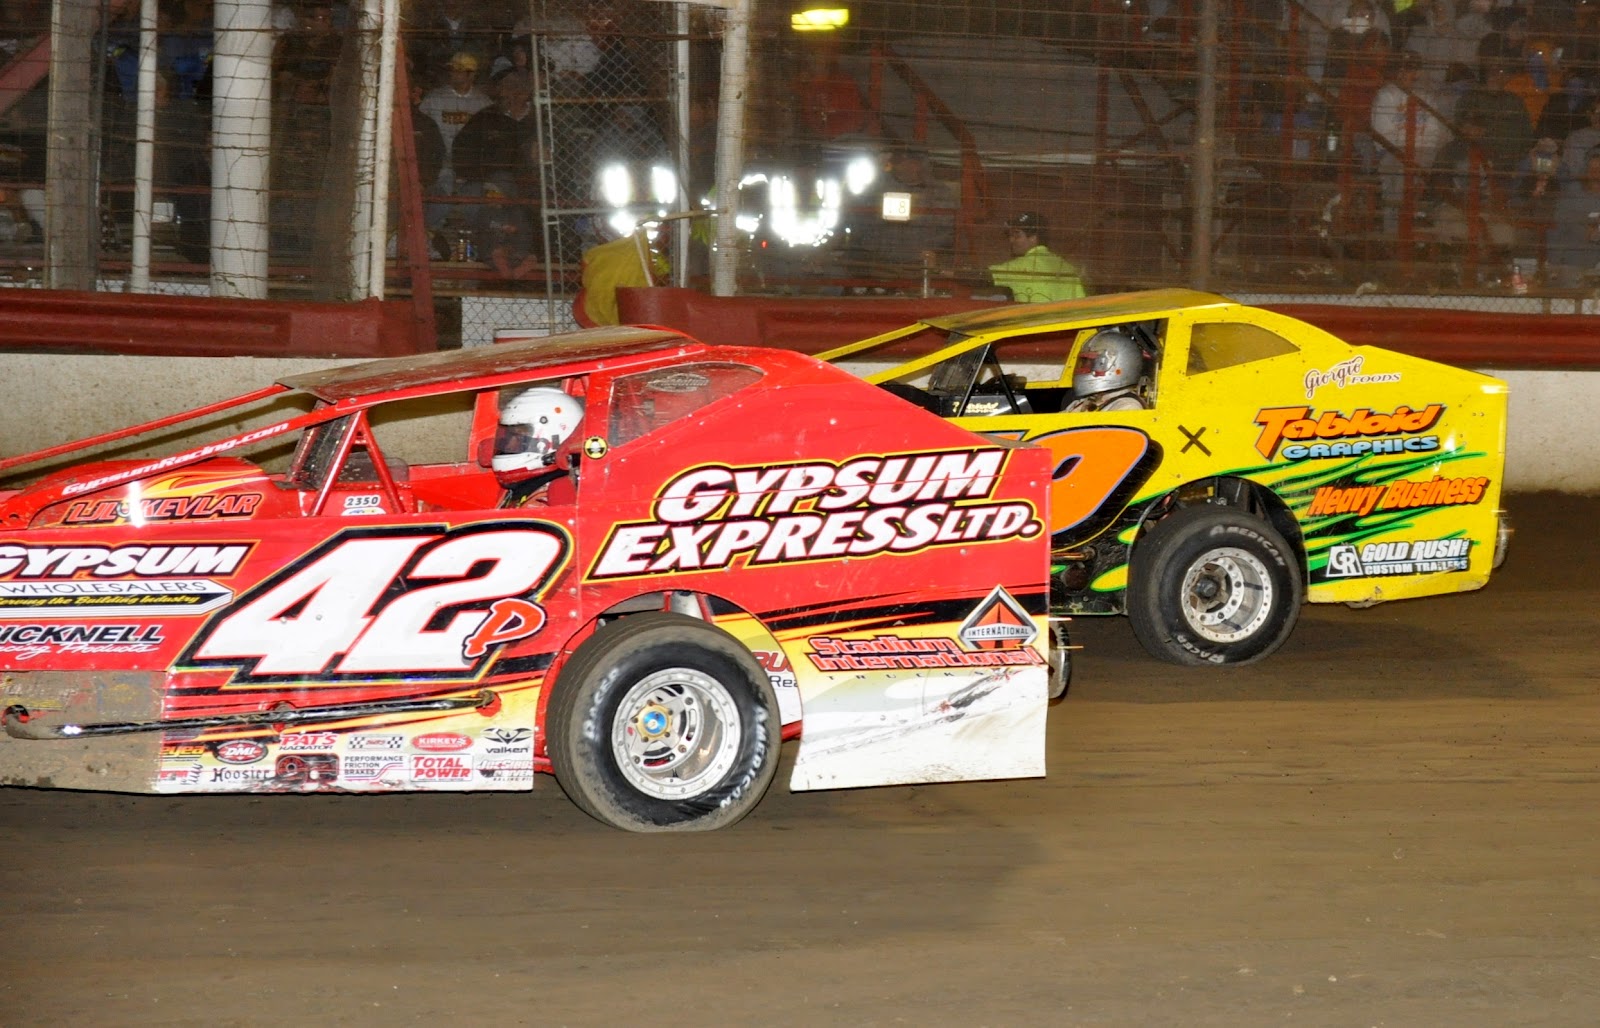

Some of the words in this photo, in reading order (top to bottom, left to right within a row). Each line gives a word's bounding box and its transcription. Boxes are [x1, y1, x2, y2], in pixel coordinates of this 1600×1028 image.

[1304, 355, 1364, 399] Giorgio
[1350, 373, 1401, 384] FOODS
[1254, 404, 1446, 461] Tabloid
[1282, 435, 1439, 459] GRAPHICS
[61, 422, 289, 496] GypsumRacing.com
[655, 449, 1009, 524] GYPSUM
[1306, 483, 1387, 517] Heavy
[1381, 475, 1491, 510] Business
[142, 493, 262, 518] KEVLAR
[346, 496, 379, 506] 2350
[592, 501, 941, 577] EXPRESS
[933, 500, 1041, 541] LTD.
[1209, 524, 1286, 567] AMERICAN
[0, 545, 249, 576] GYPSUM
[1361, 543, 1410, 563] GOLD
[1410, 539, 1464, 560] RUSH
[1364, 564, 1412, 575] CUSTOM
[0, 581, 208, 596] WHOLESALERS
[48, 596, 73, 606] the
[74, 595, 139, 606] Building
[139, 595, 201, 605] Industry
[192, 530, 562, 675] 42
[0, 625, 165, 644] ICKNELL
[967, 626, 1030, 637] INTERNATIONAL
[56, 643, 160, 655] Products
[809, 636, 958, 656] Stadium
[808, 646, 1045, 671] International
[282, 733, 338, 746] PAT'S
[160, 745, 206, 758] eyea
[225, 747, 256, 756] DMI
[485, 746, 530, 754] valken
[413, 756, 463, 768] TOTAL
[210, 766, 270, 782] Hoosier
[414, 768, 471, 778] POWER
